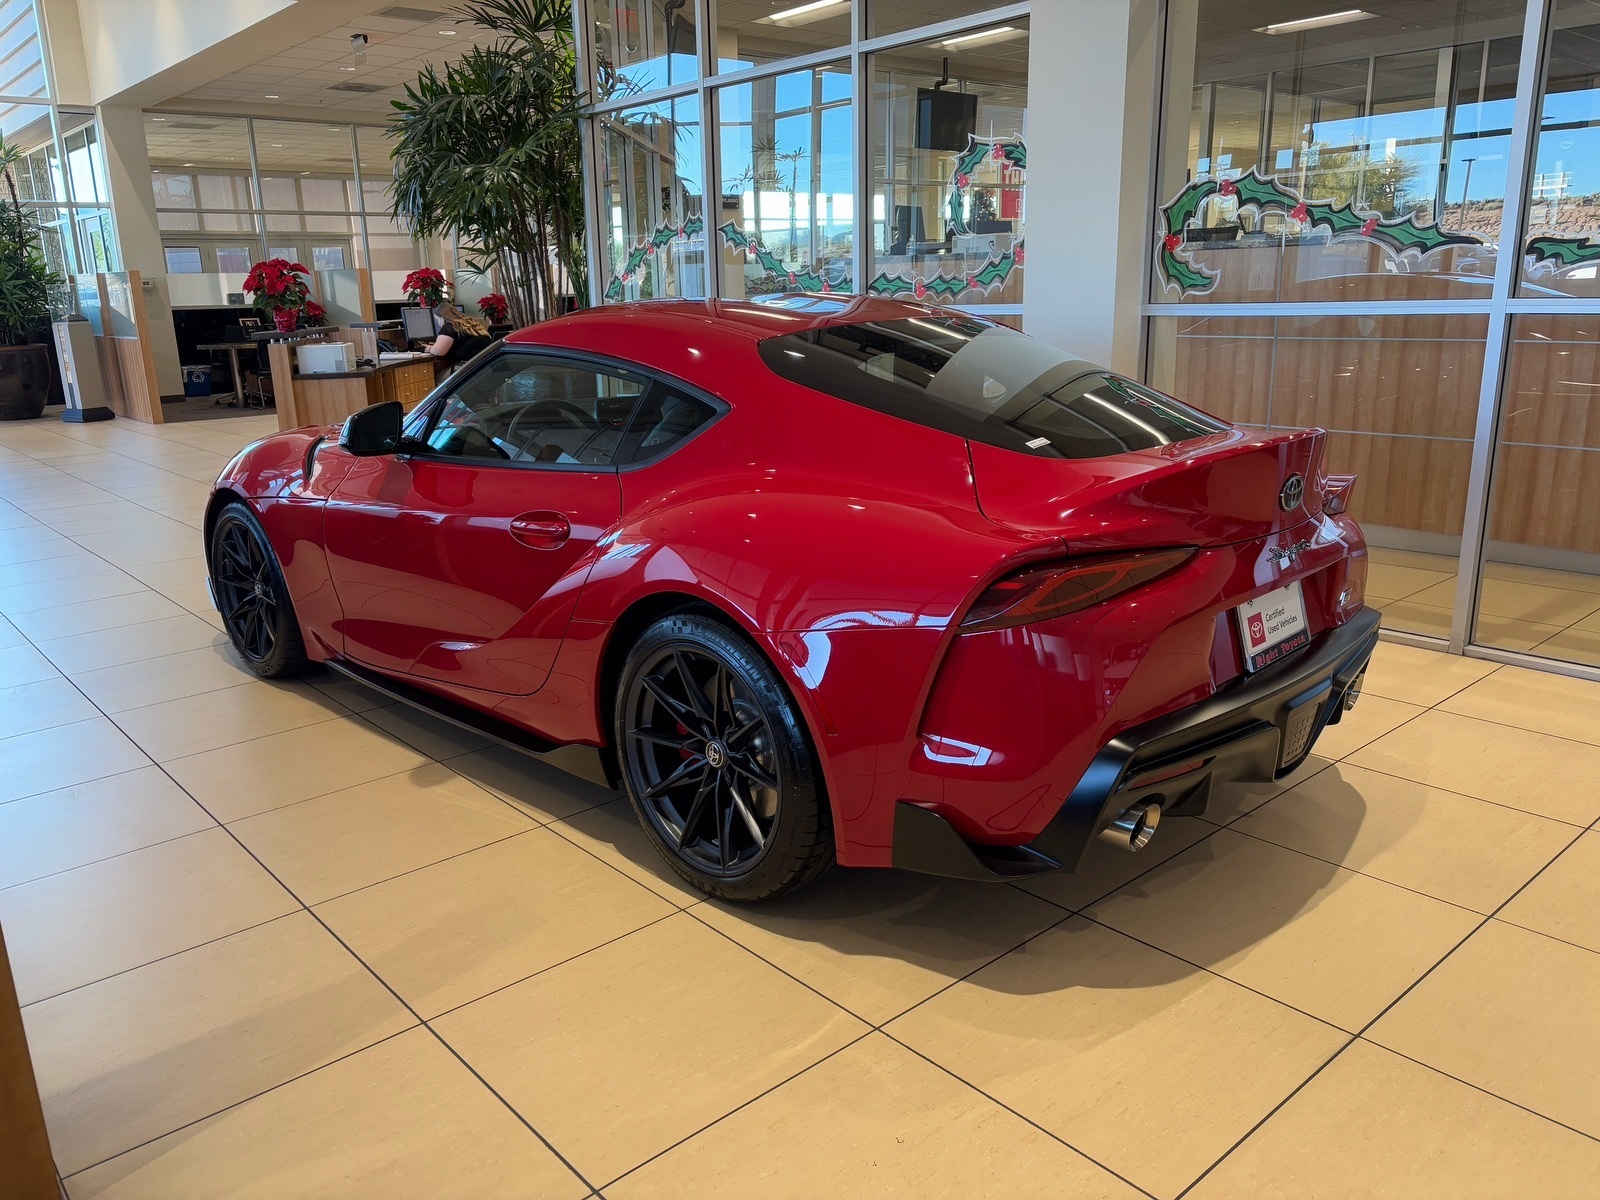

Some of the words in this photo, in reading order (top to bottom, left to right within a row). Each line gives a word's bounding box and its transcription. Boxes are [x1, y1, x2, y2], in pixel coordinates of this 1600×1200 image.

[1265, 606, 1286, 622] Certified
[1267, 624, 1280, 635] Used
[1280, 614, 1298, 628] Vehicles
[1255, 648, 1279, 668] Right
[1281, 633, 1306, 654] Toyota
